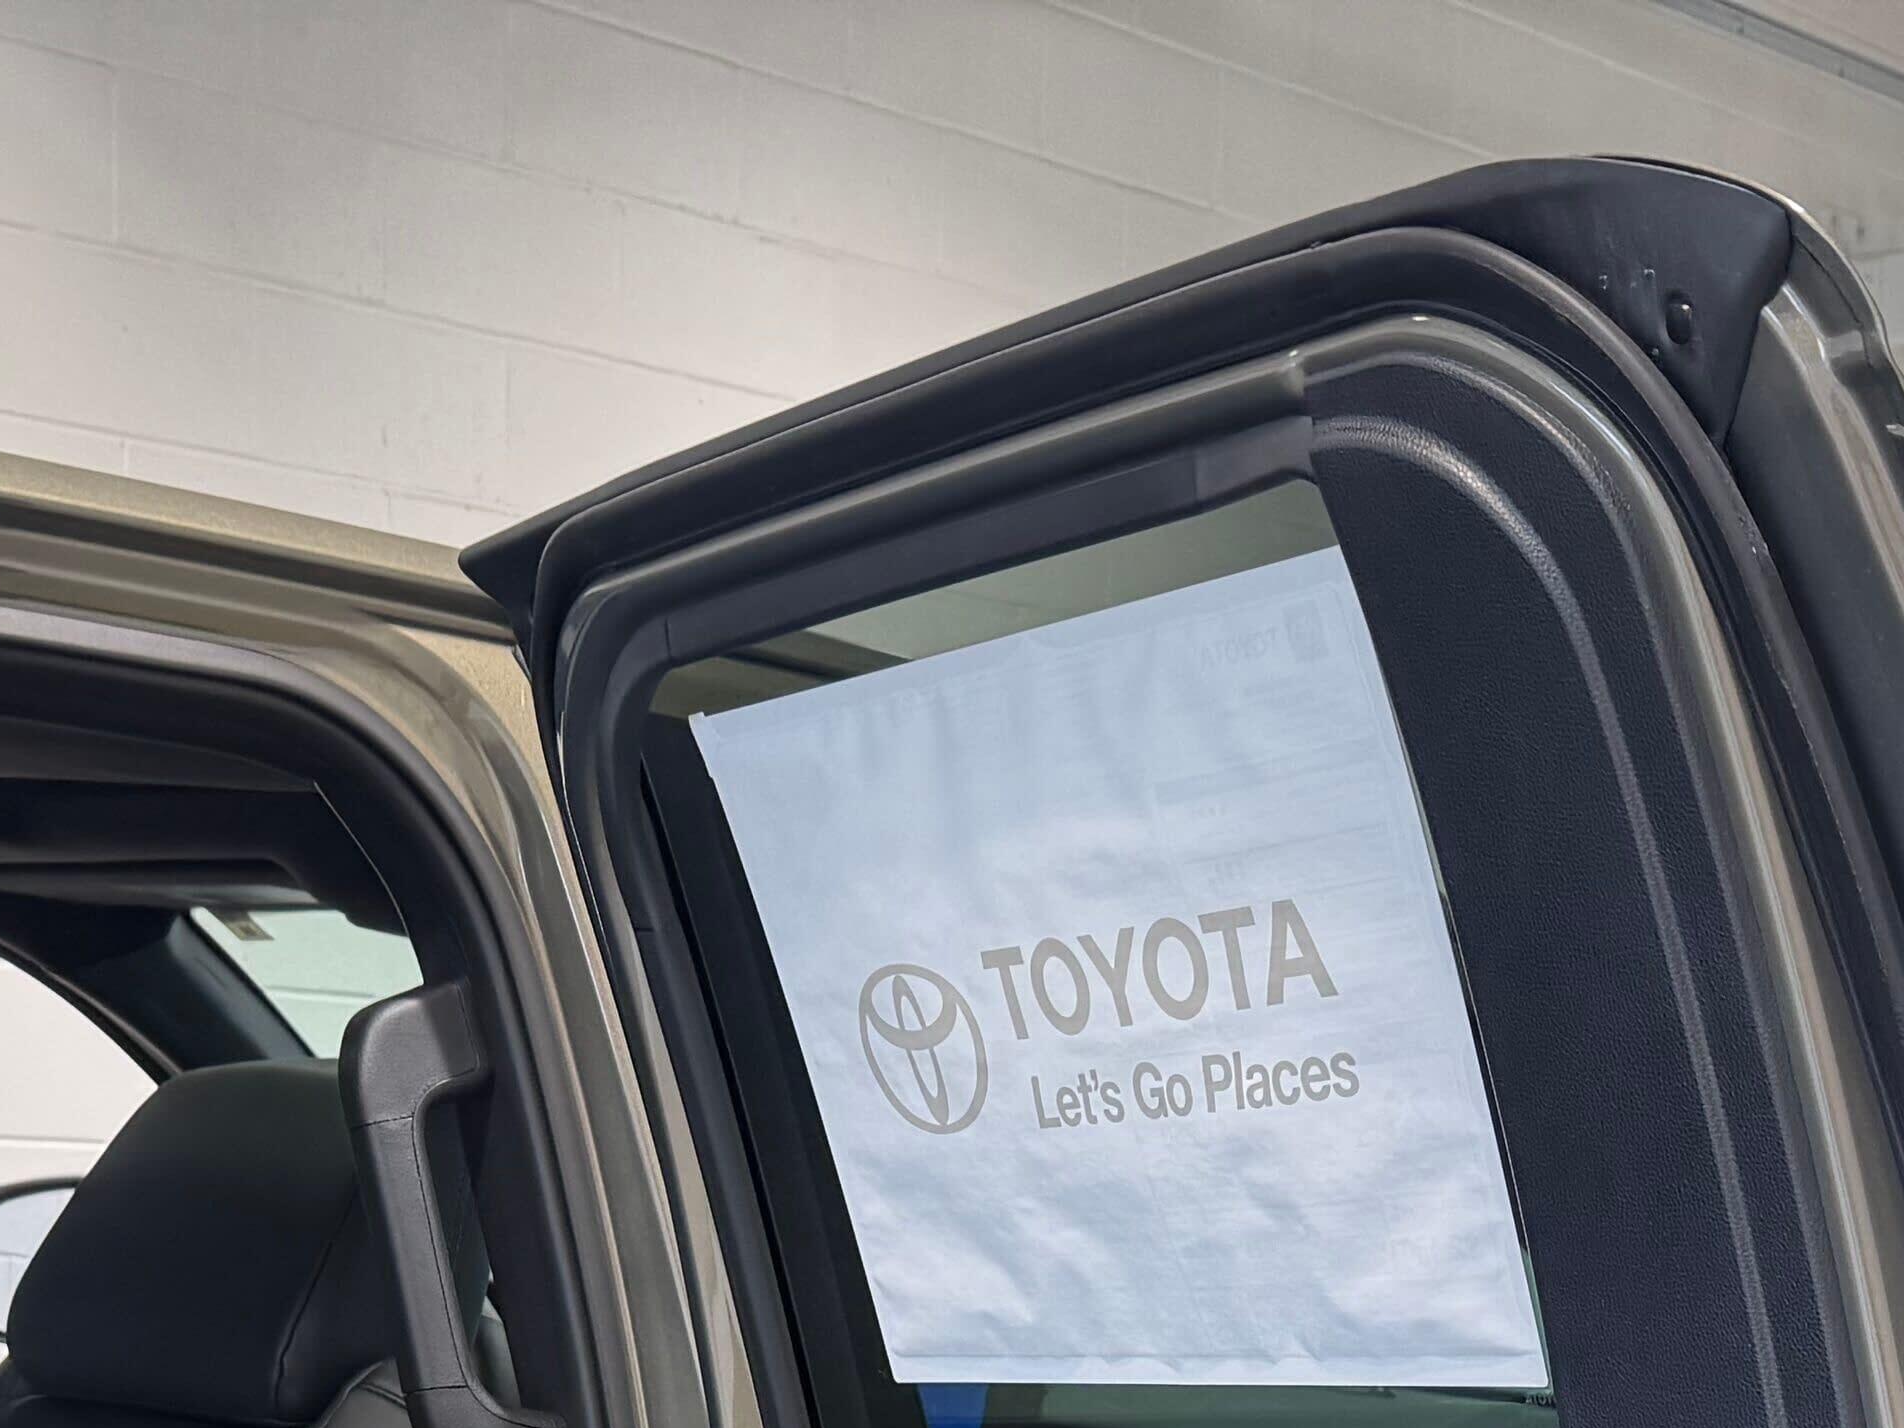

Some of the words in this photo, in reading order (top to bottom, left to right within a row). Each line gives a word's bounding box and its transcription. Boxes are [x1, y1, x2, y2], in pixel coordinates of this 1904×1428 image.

[981, 899, 1339, 1041] TOYOTA
[1031, 1072, 1126, 1130] Let's
[1133, 1063, 1194, 1120] Go
[1203, 1050, 1360, 1113] Places
